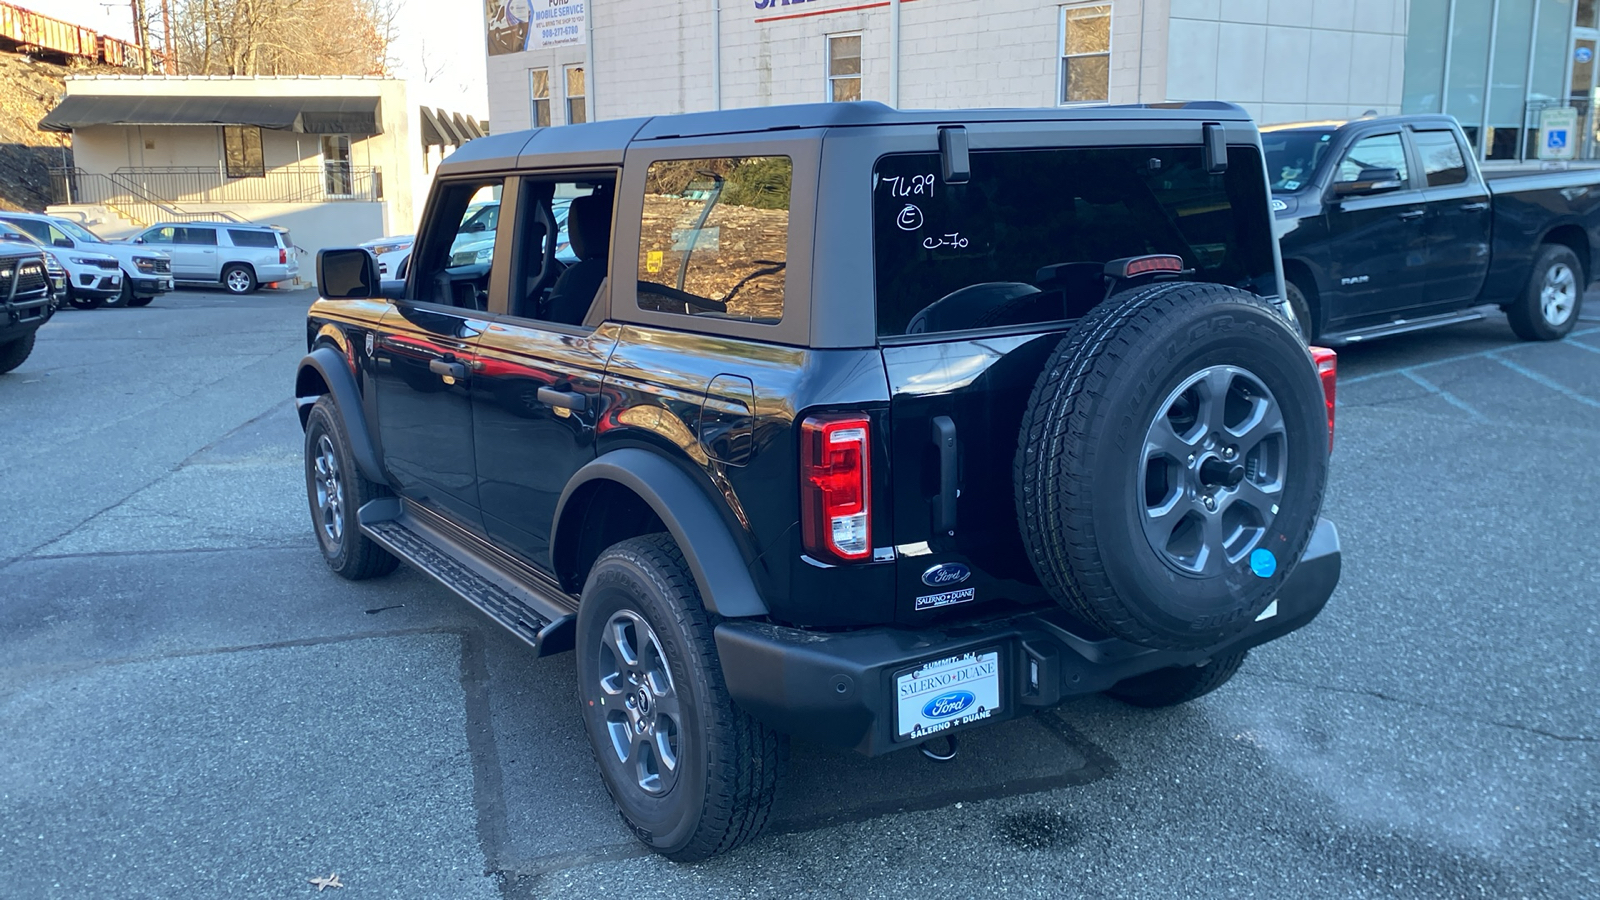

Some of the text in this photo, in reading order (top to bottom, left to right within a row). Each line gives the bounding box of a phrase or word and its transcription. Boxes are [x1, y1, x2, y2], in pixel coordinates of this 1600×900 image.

[536, 4, 584, 20] MOBILE SERVICE
[542, 25, 578, 38] 908-277-6780
[882, 174, 935, 198] 7629
[1340, 275, 1370, 286] RAM
[934, 569, 961, 582] Ford
[918, 594, 946, 605] SALERNO
[952, 590, 973, 599] DUANE
[901, 662, 995, 697] SALERNO DUANE
[932, 695, 965, 716] Ford
[910, 710, 991, 739] SALERNO DUANE
